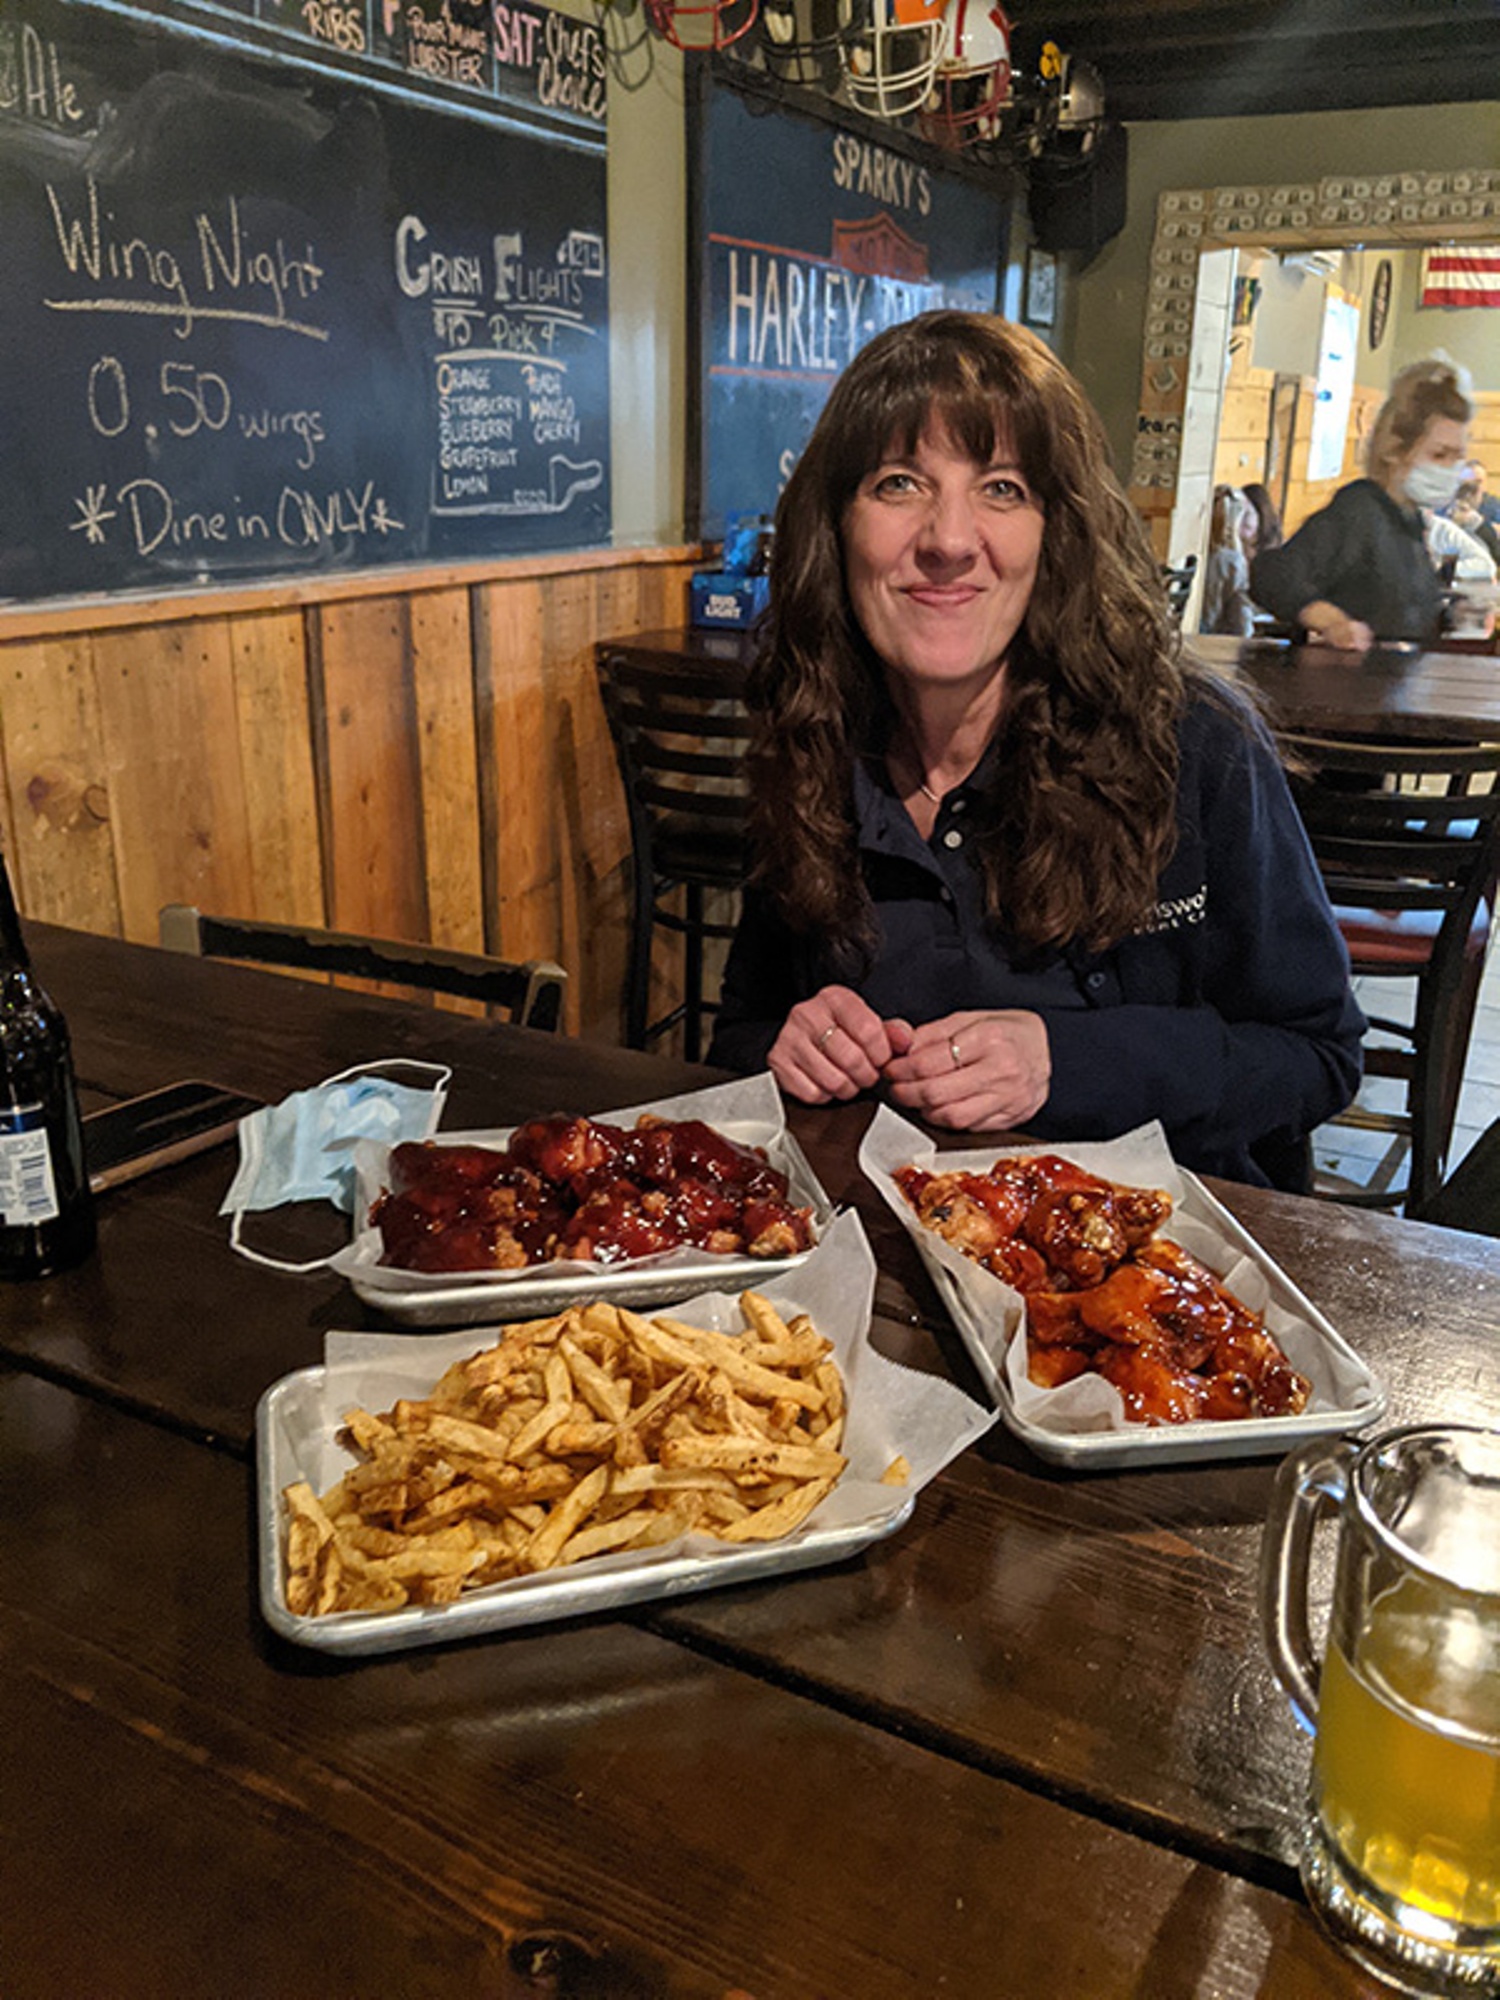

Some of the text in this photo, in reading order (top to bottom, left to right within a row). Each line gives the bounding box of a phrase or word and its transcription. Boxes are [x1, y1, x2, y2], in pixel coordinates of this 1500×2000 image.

[302, 2, 364, 51] RIBS
[22, 23, 84, 122] Ale
[409, 39, 485, 88] LOBSTER
[46, 175, 324, 339] Wing Night
[396, 214, 583, 305] CRUSH FLIGHTS
[437, 363, 491, 395] ORANGE
[88, 356, 326, 470] 0.50 wings
[439, 418, 513, 443] BLUEBERRY
[534, 420, 581, 445] CHERRY
[236, 496, 269, 538] in
